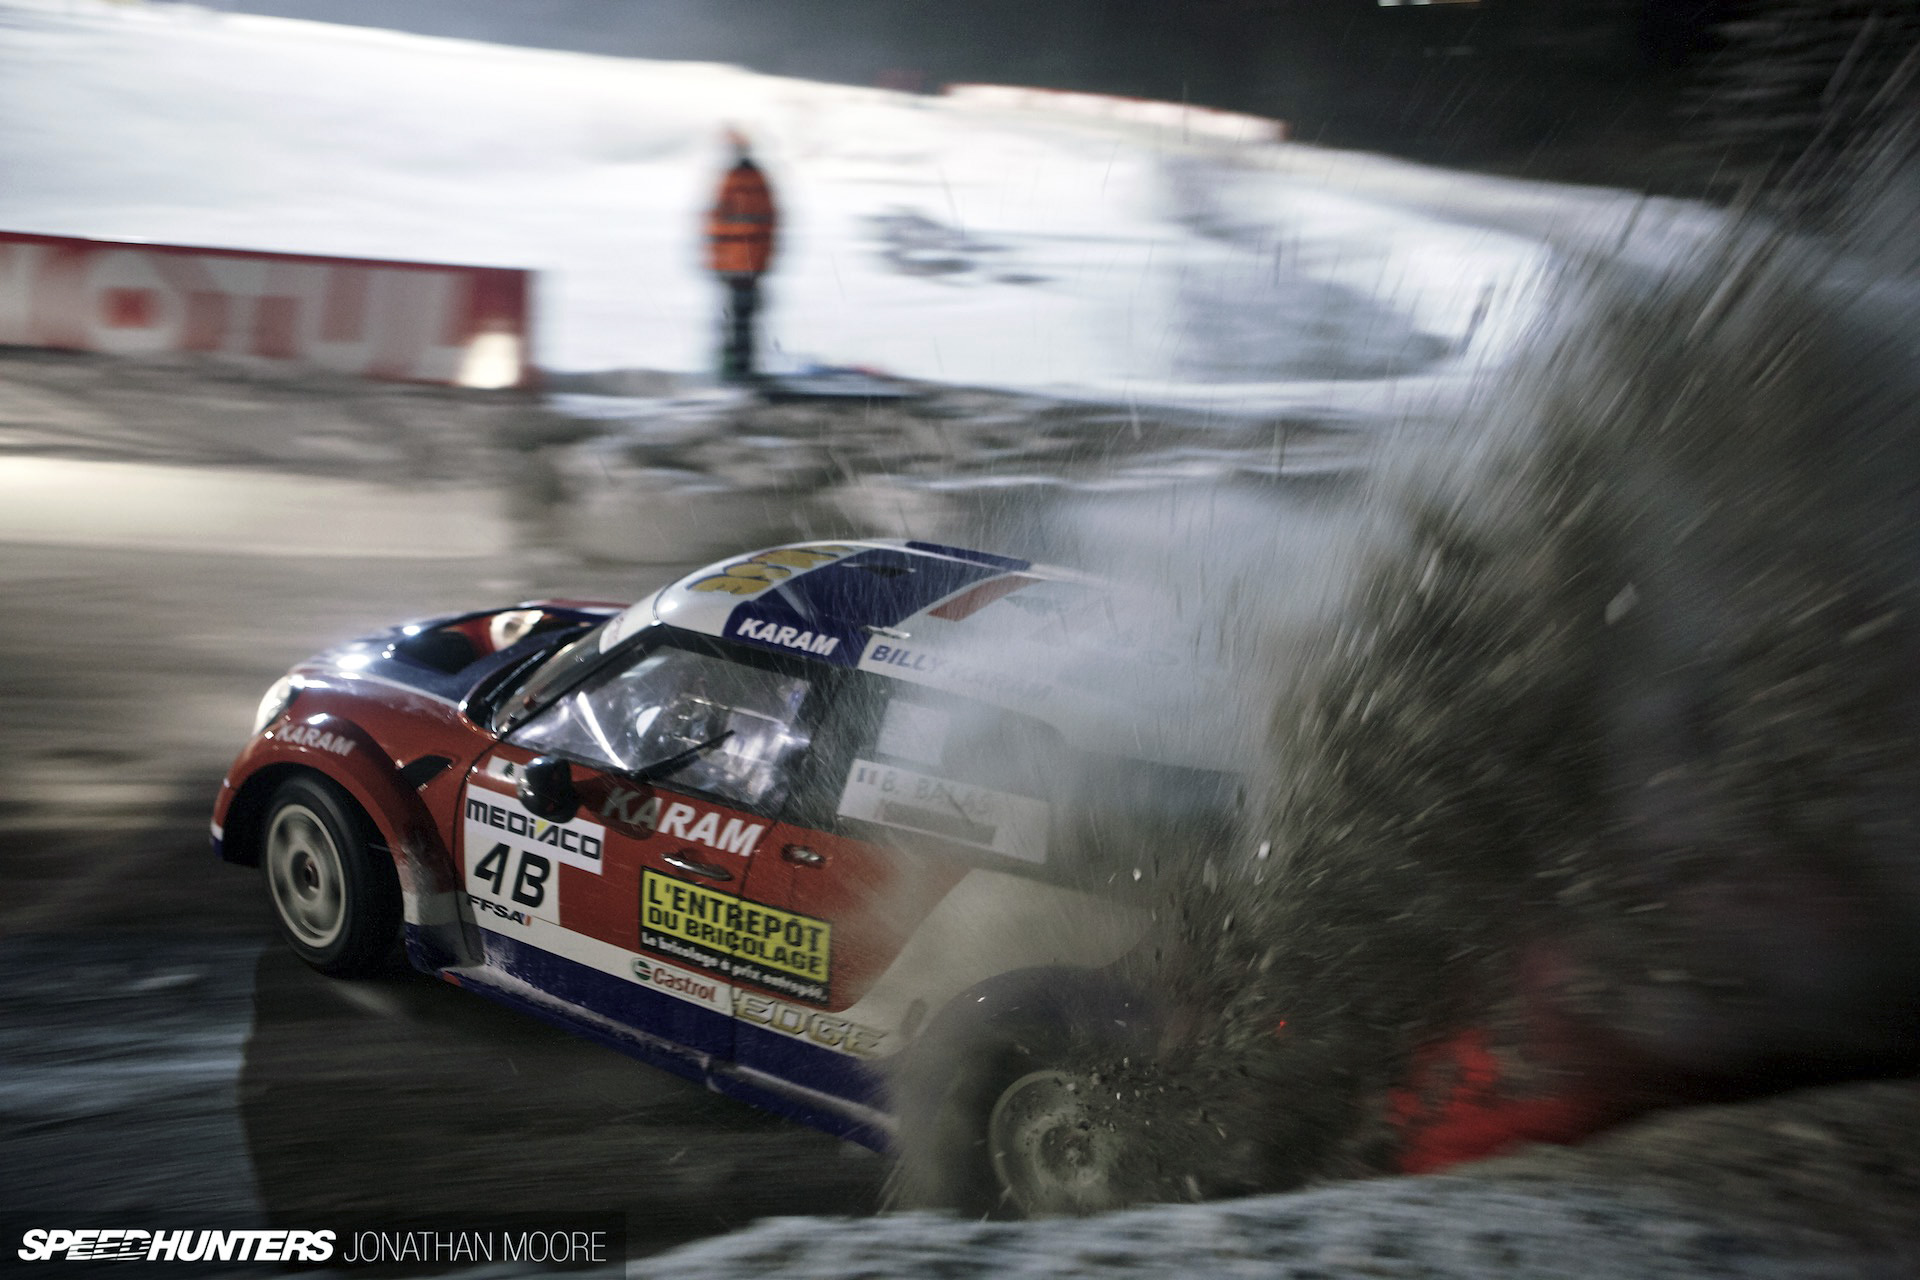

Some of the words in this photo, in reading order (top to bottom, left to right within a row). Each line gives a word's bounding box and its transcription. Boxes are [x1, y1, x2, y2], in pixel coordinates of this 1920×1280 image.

[737, 617, 841, 657] KARAM
[869, 643, 947, 673] BILLY
[275, 722, 358, 757] KARAM
[602, 785, 765, 858] KARAM
[473, 841, 551, 908] 4B
[648, 905, 679, 931] DU
[686, 917, 823, 976] BRICOLAGE
[653, 968, 716, 1004] Castrol
[733, 985, 888, 1059] EDGE
